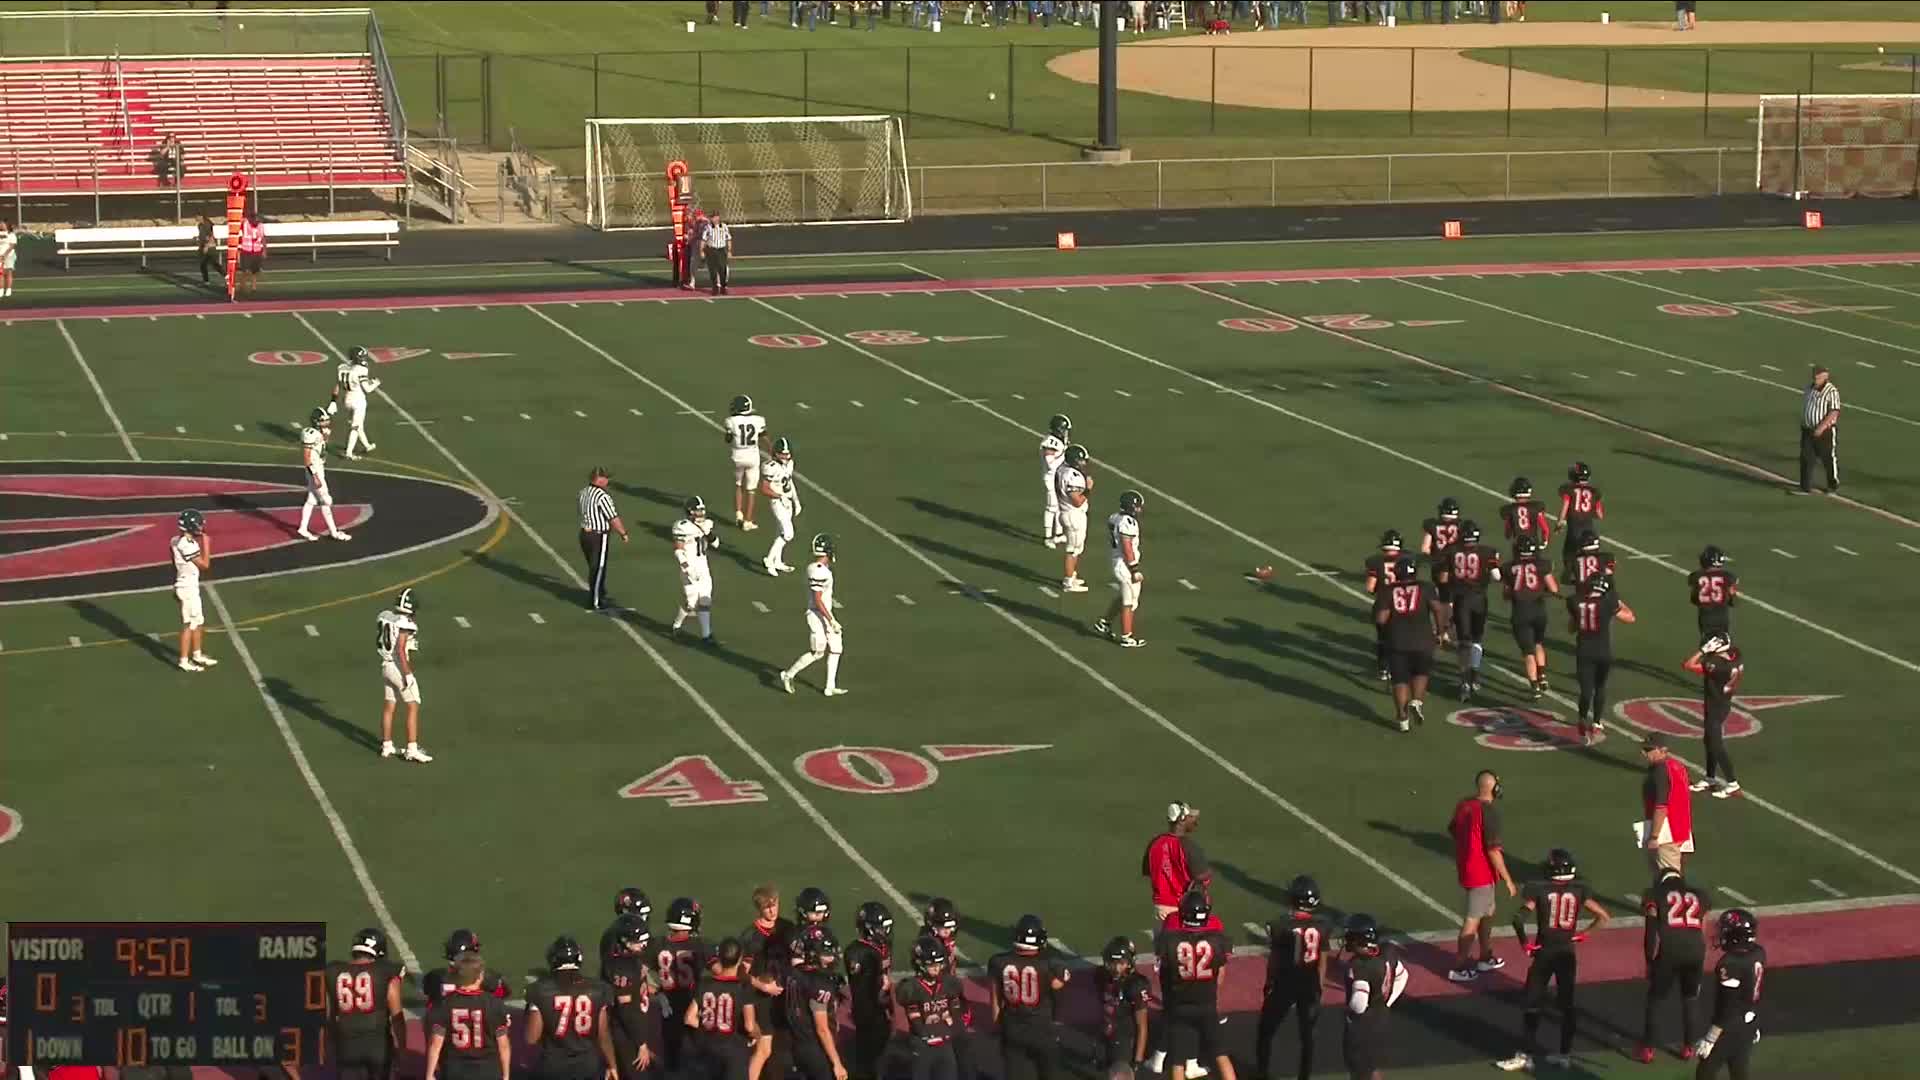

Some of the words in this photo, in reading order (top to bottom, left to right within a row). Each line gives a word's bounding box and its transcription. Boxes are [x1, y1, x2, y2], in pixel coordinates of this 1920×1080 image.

[738, 423, 756, 446] 12
[1573, 487, 1592, 513] 13
[1517, 506, 1529, 530] 8
[1436, 525, 1459, 546] 52
[1454, 552, 1480, 579] 99
[1512, 563, 1538, 592] 76
[1577, 555, 1597, 582] 18
[1393, 585, 1420, 615] 67
[1698, 576, 1725, 603] 25
[1578, 602, 1598, 633] 11
[617, 746, 939, 807] 40
[1547, 891, 1577, 929] 10
[1666, 890, 1700, 928] 22
[1176, 939, 1214, 981] 92
[336, 971, 374, 1013] 69
[1001, 963, 1040, 1007] 60
[451, 1008, 483, 1049] 51
[553, 994, 593, 1038] 78
[701, 991, 735, 1035] 80
